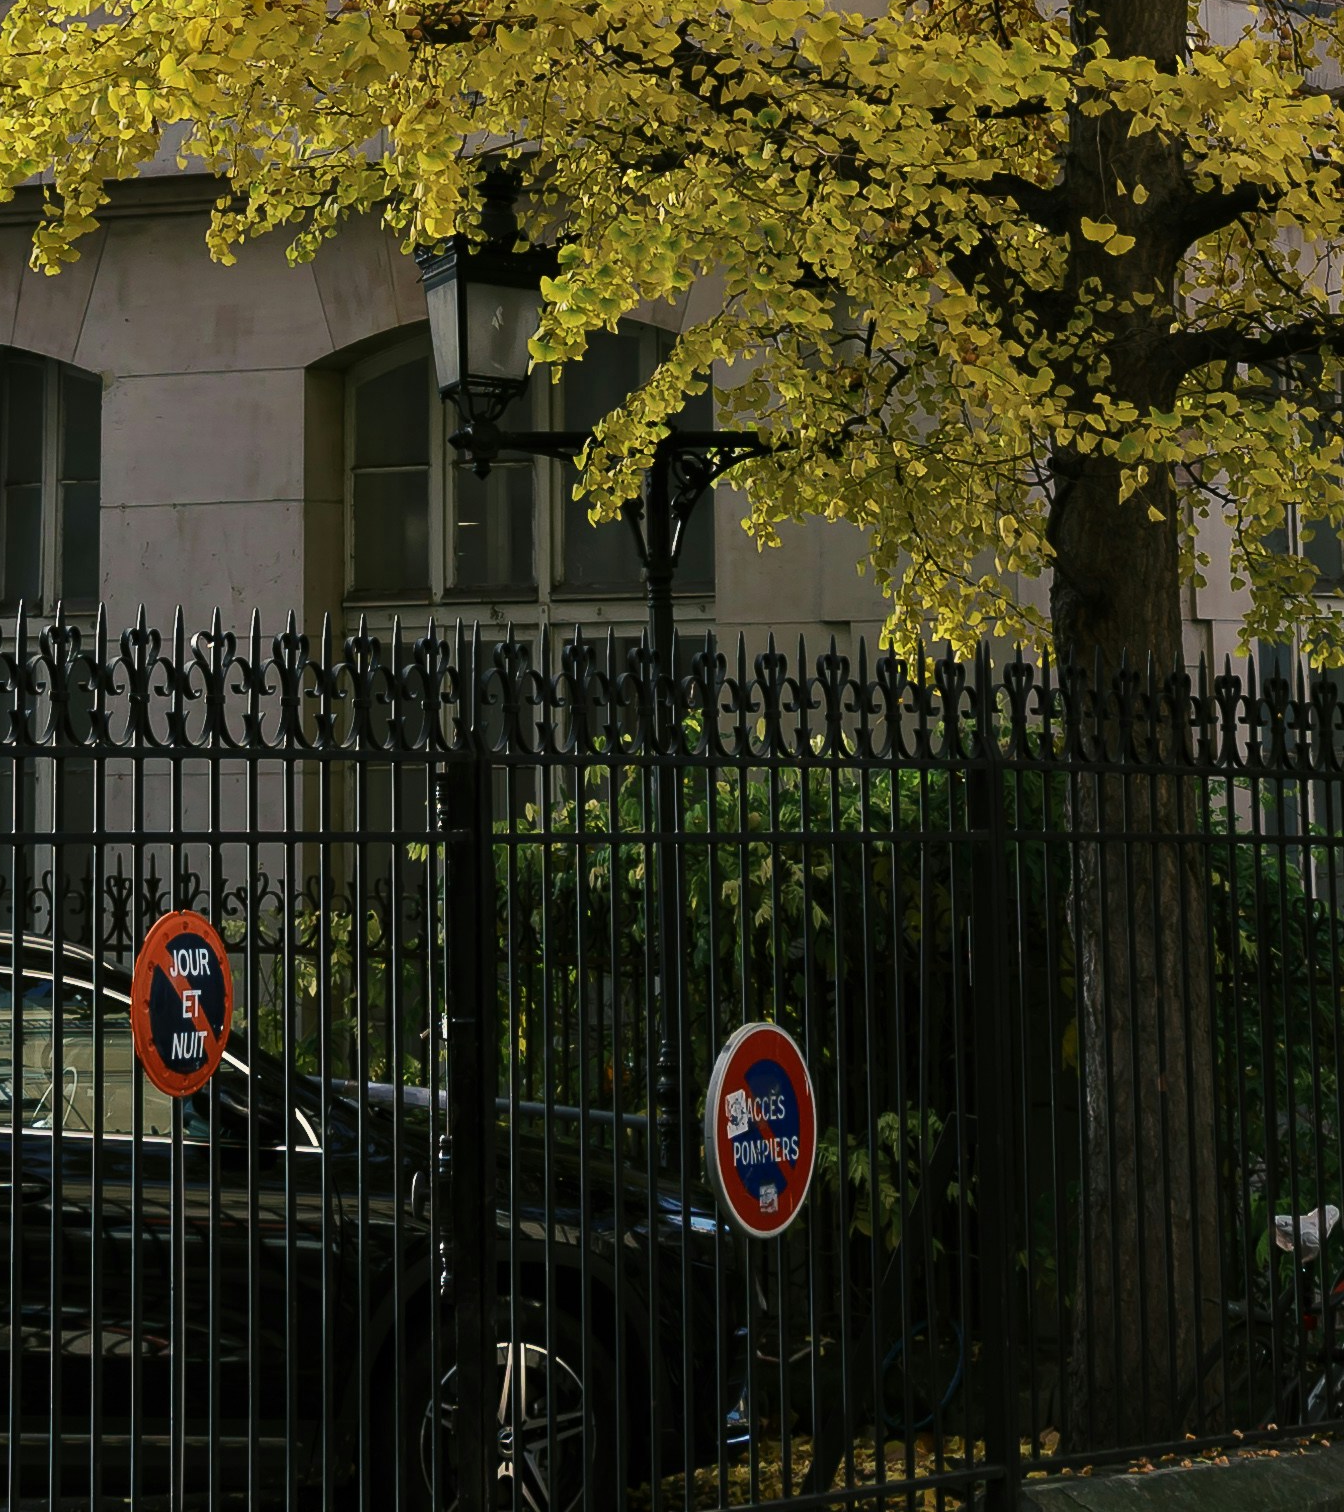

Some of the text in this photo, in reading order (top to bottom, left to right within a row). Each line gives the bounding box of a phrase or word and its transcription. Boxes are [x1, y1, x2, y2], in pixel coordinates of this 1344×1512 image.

[169, 948, 211, 977] JOUR
[182, 989, 202, 1019] ET
[171, 1031, 208, 1060] NUIT
[746, 1091, 786, 1122] ACCÈS
[733, 1136, 800, 1167] POMPIERS
